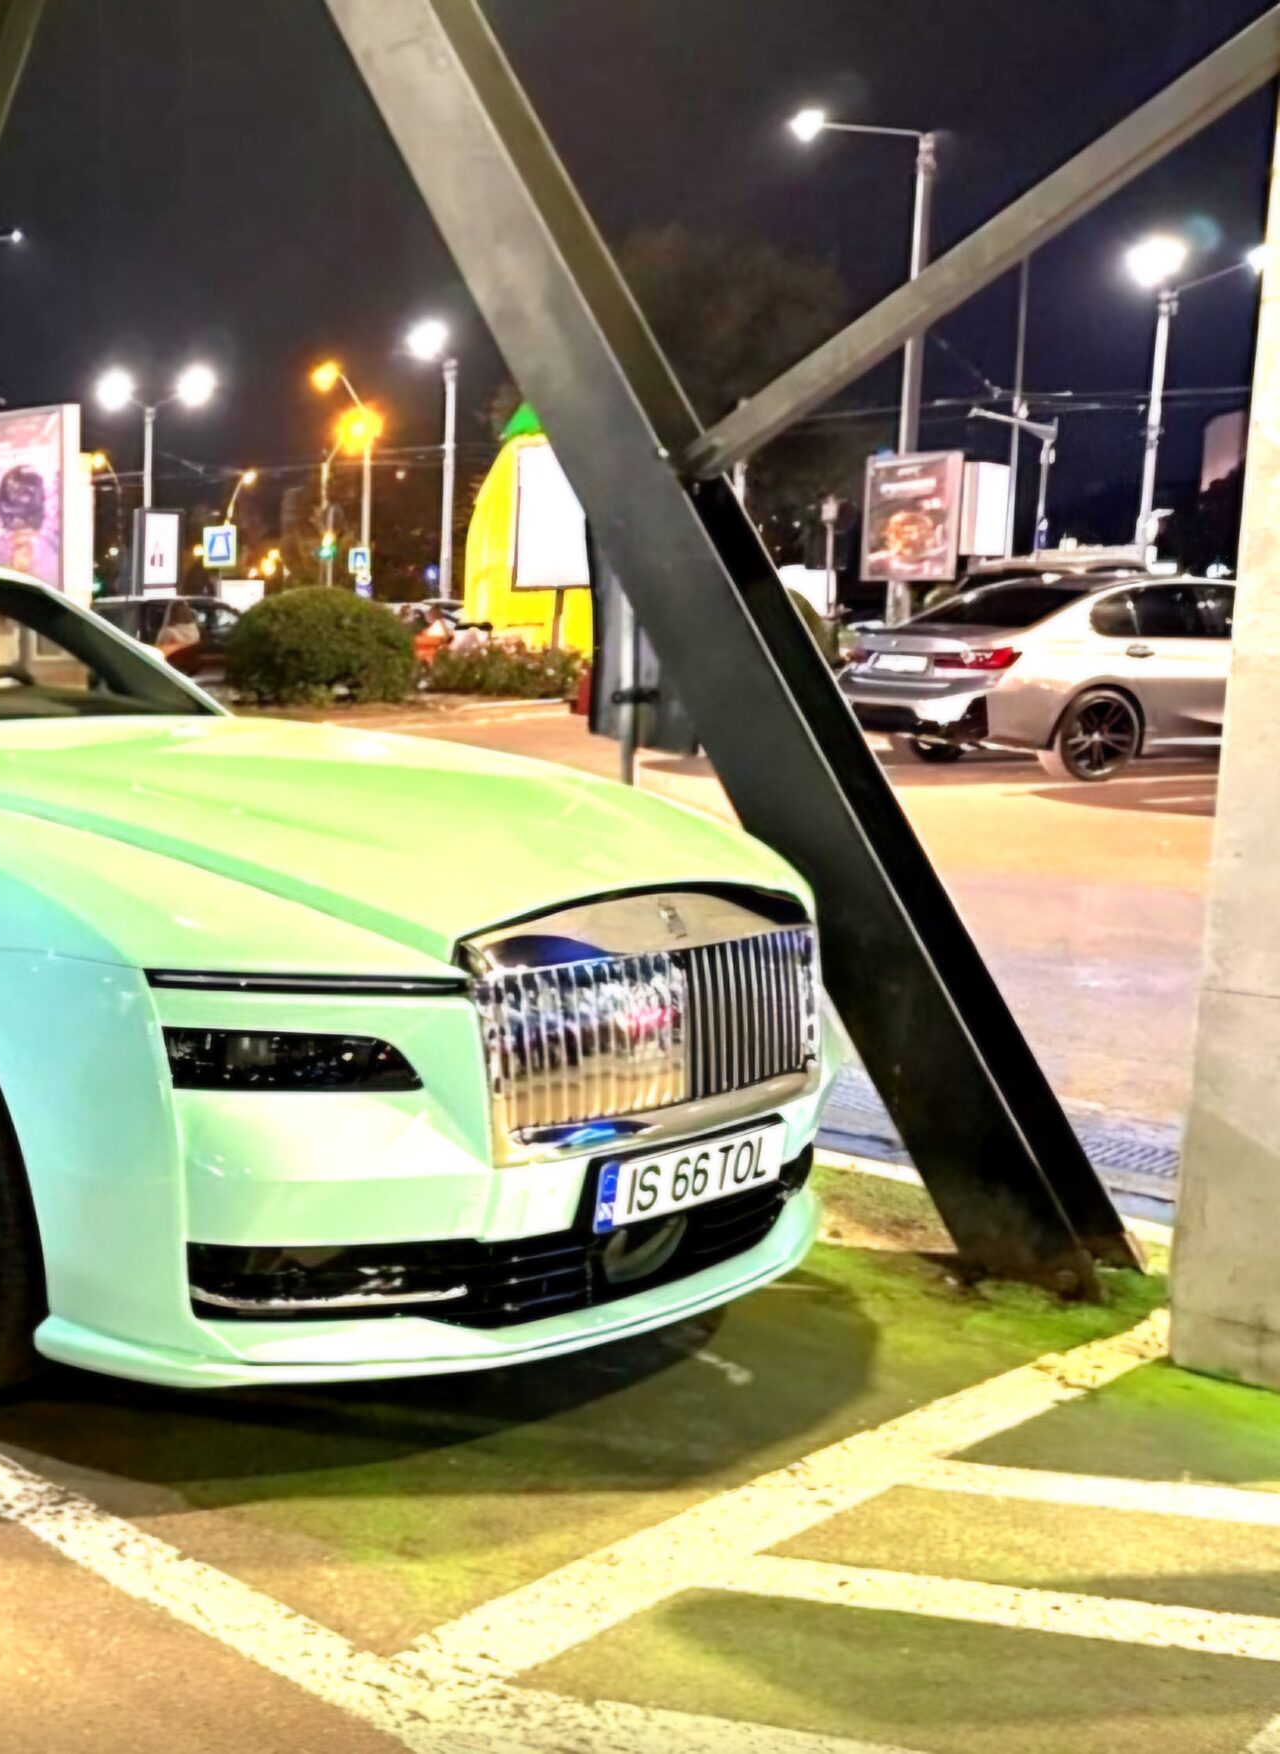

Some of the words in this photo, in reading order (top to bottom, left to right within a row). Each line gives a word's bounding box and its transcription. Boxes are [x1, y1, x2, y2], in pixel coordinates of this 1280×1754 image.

[626, 1164, 661, 1215] IS
[671, 1152, 710, 1202] 66
[718, 1136, 767, 1190] TOL
